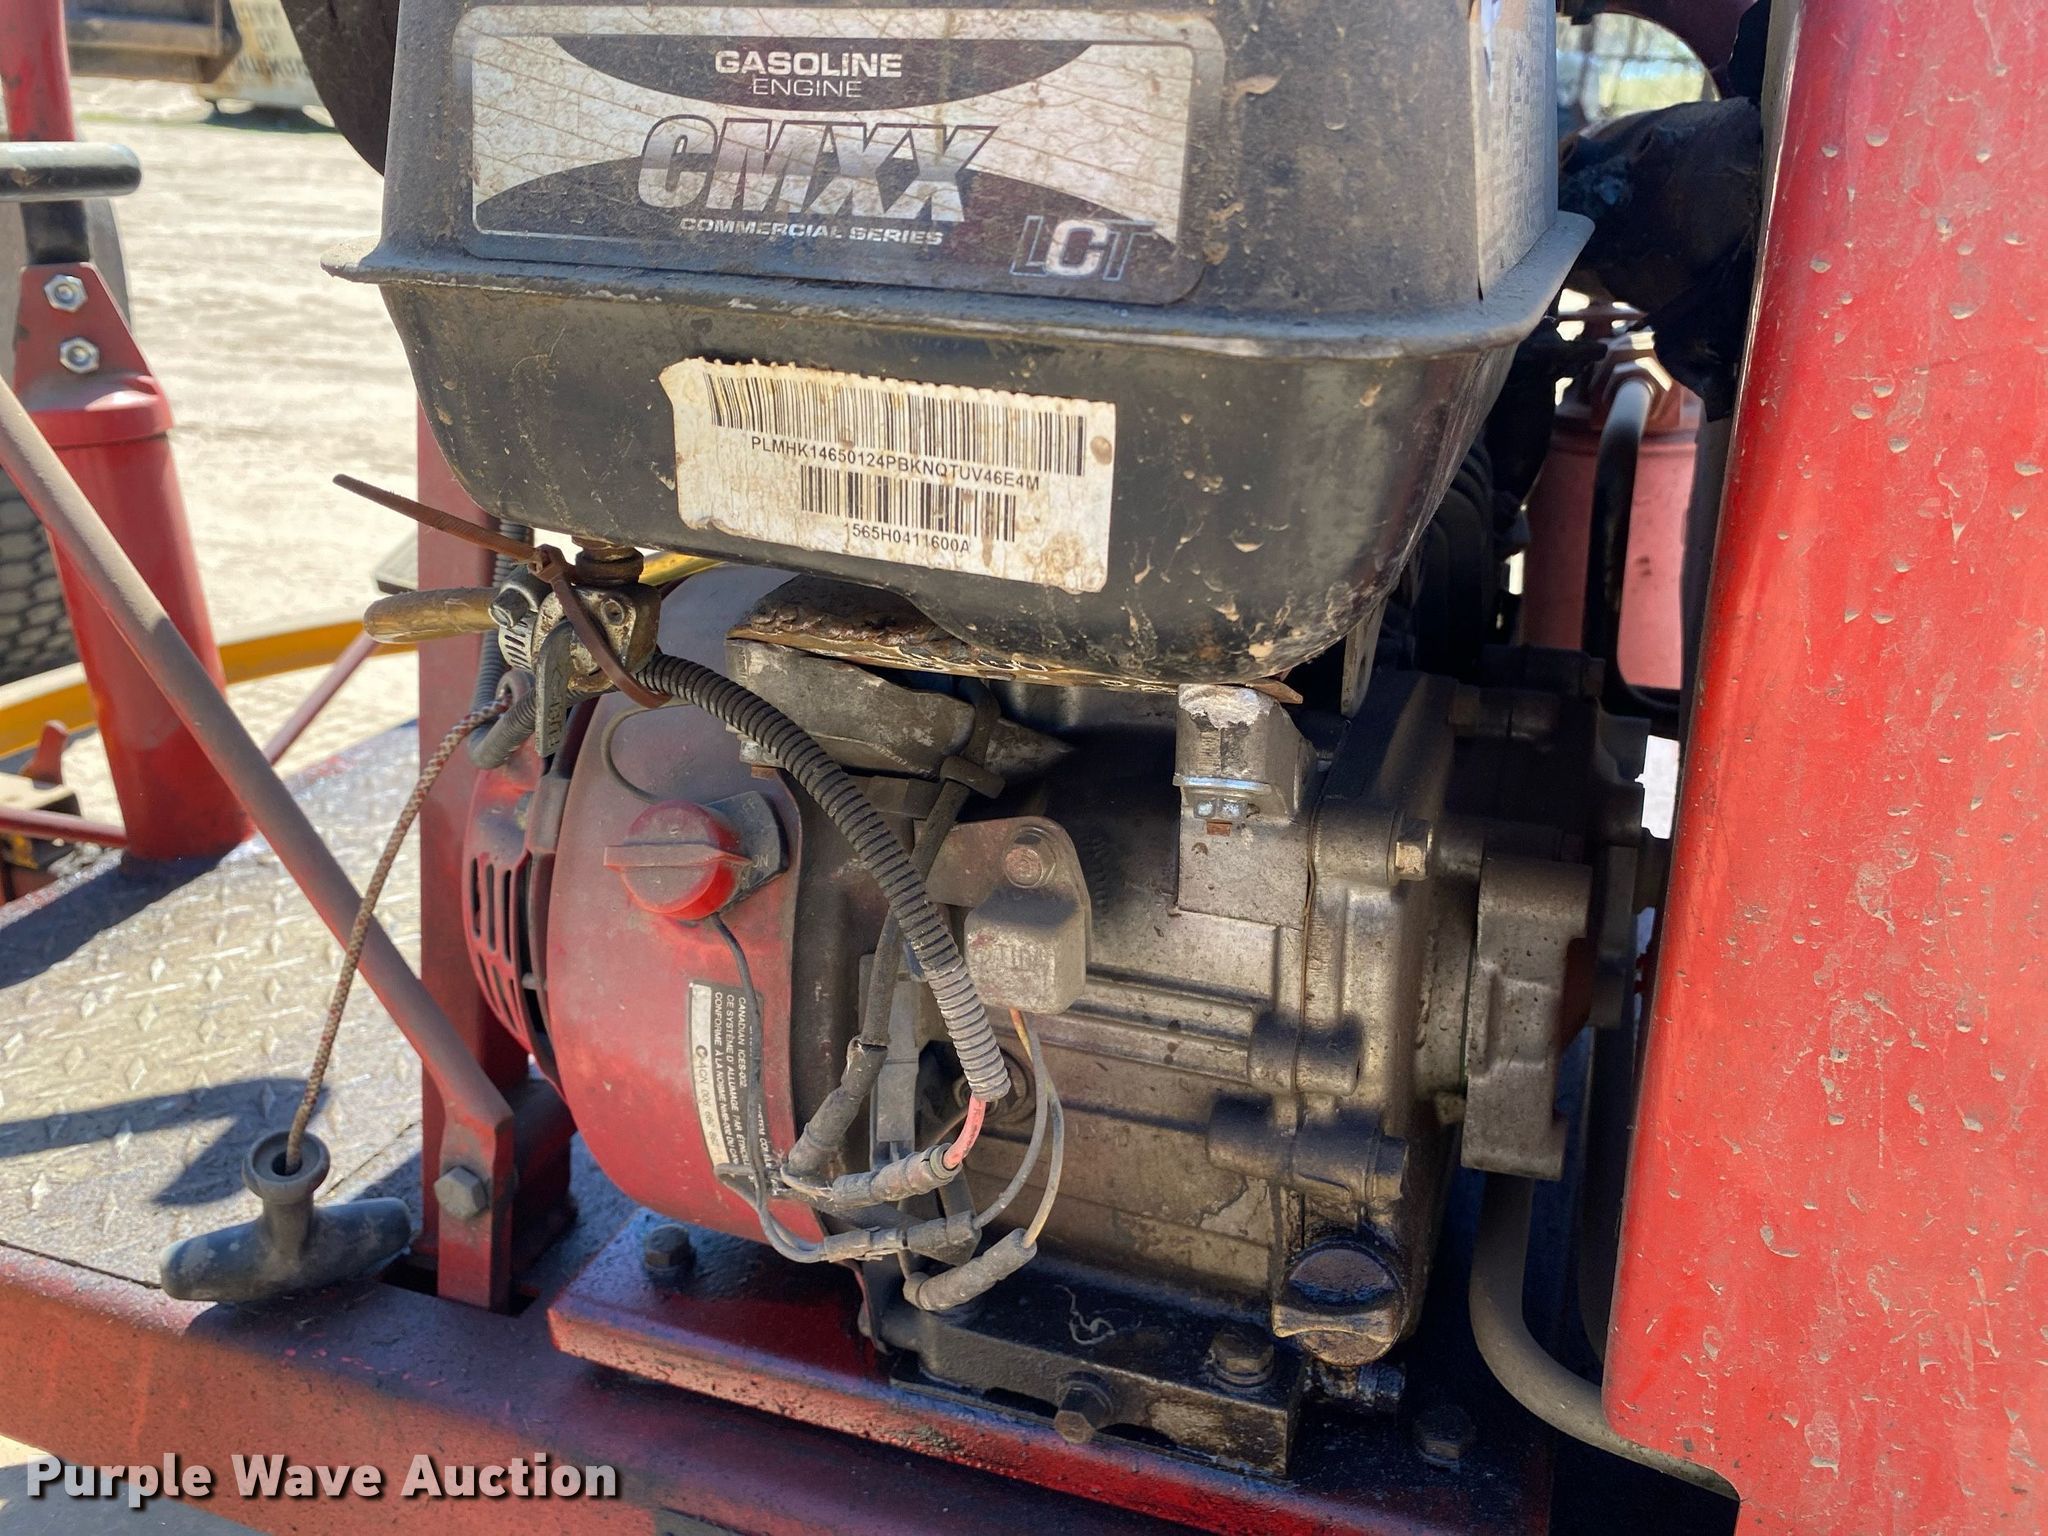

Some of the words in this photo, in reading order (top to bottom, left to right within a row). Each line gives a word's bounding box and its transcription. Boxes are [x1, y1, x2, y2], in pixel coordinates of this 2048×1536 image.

[715, 50, 902, 78] GASOLINE
[753, 78, 862, 98] ENGINE
[638, 114, 998, 223] CMXX
[680, 217, 843, 239] COMMERCIAL
[849, 226, 944, 246] SERIES
[1010, 215, 1157, 282] LCT
[714, 992, 723, 1046] CONFORME
[727, 994, 735, 1009] CE
[737, 996, 747, 1046] CANADIAN
[726, 1009, 735, 1053] SYSTÈME
[715, 1057, 723, 1069] LA
[727, 1065, 739, 1112] ALLUMAGE
